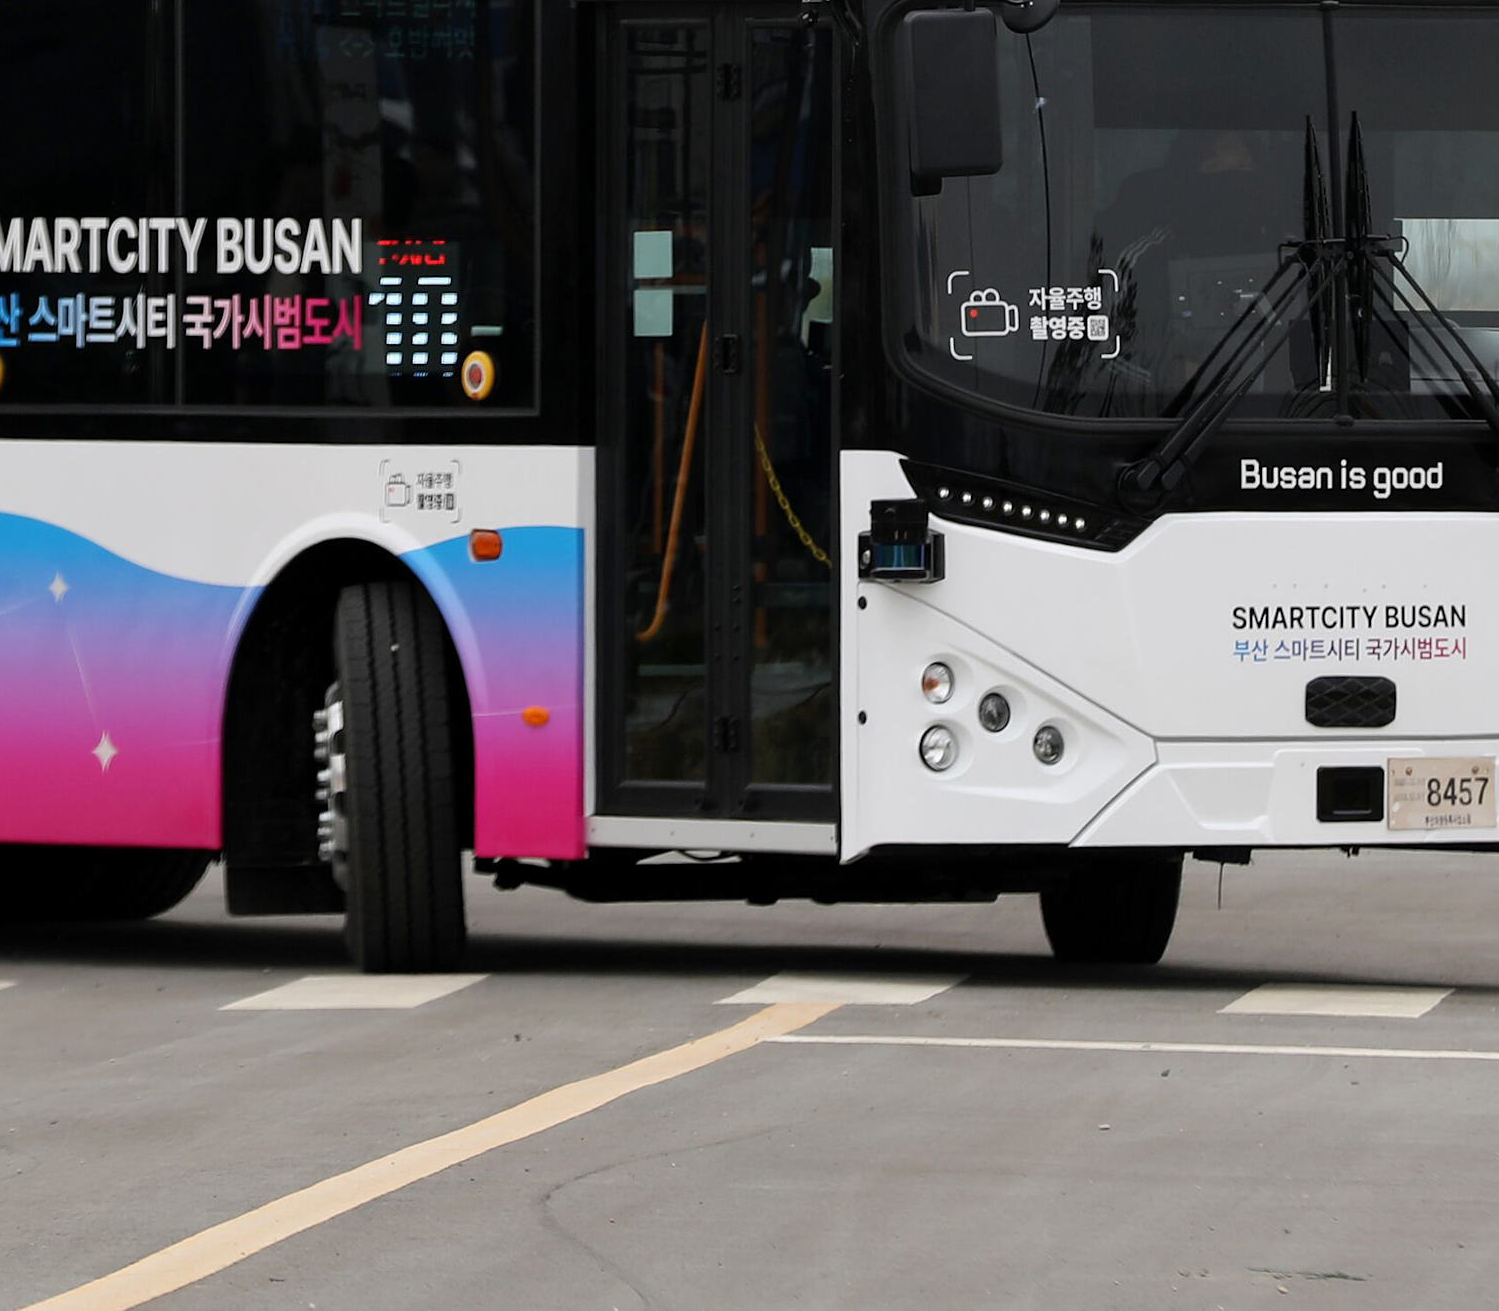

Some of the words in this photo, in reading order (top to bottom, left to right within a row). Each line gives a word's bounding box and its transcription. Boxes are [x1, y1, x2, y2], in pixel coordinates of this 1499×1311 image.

[216, 217, 363, 275] BUSAN
[1028, 286, 1103, 311] 자율주행
[27, 293, 177, 349] 스마트시티
[182, 293, 363, 351] 국가시범도시
[1029, 315, 1086, 341] 촬영중
[1240, 459, 1333, 490] Busan
[1340, 459, 1366, 490] is
[1373, 462, 1443, 500] good
[1232, 606, 1378, 630] SMARTCITY
[1385, 605, 1467, 629] BUSAN
[1233, 639, 1269, 662] 부산
[1273, 638, 1360, 662] 스마트시티
[1365, 637, 1467, 661] 국가시범도시
[1426, 776, 1490, 807] 8457
